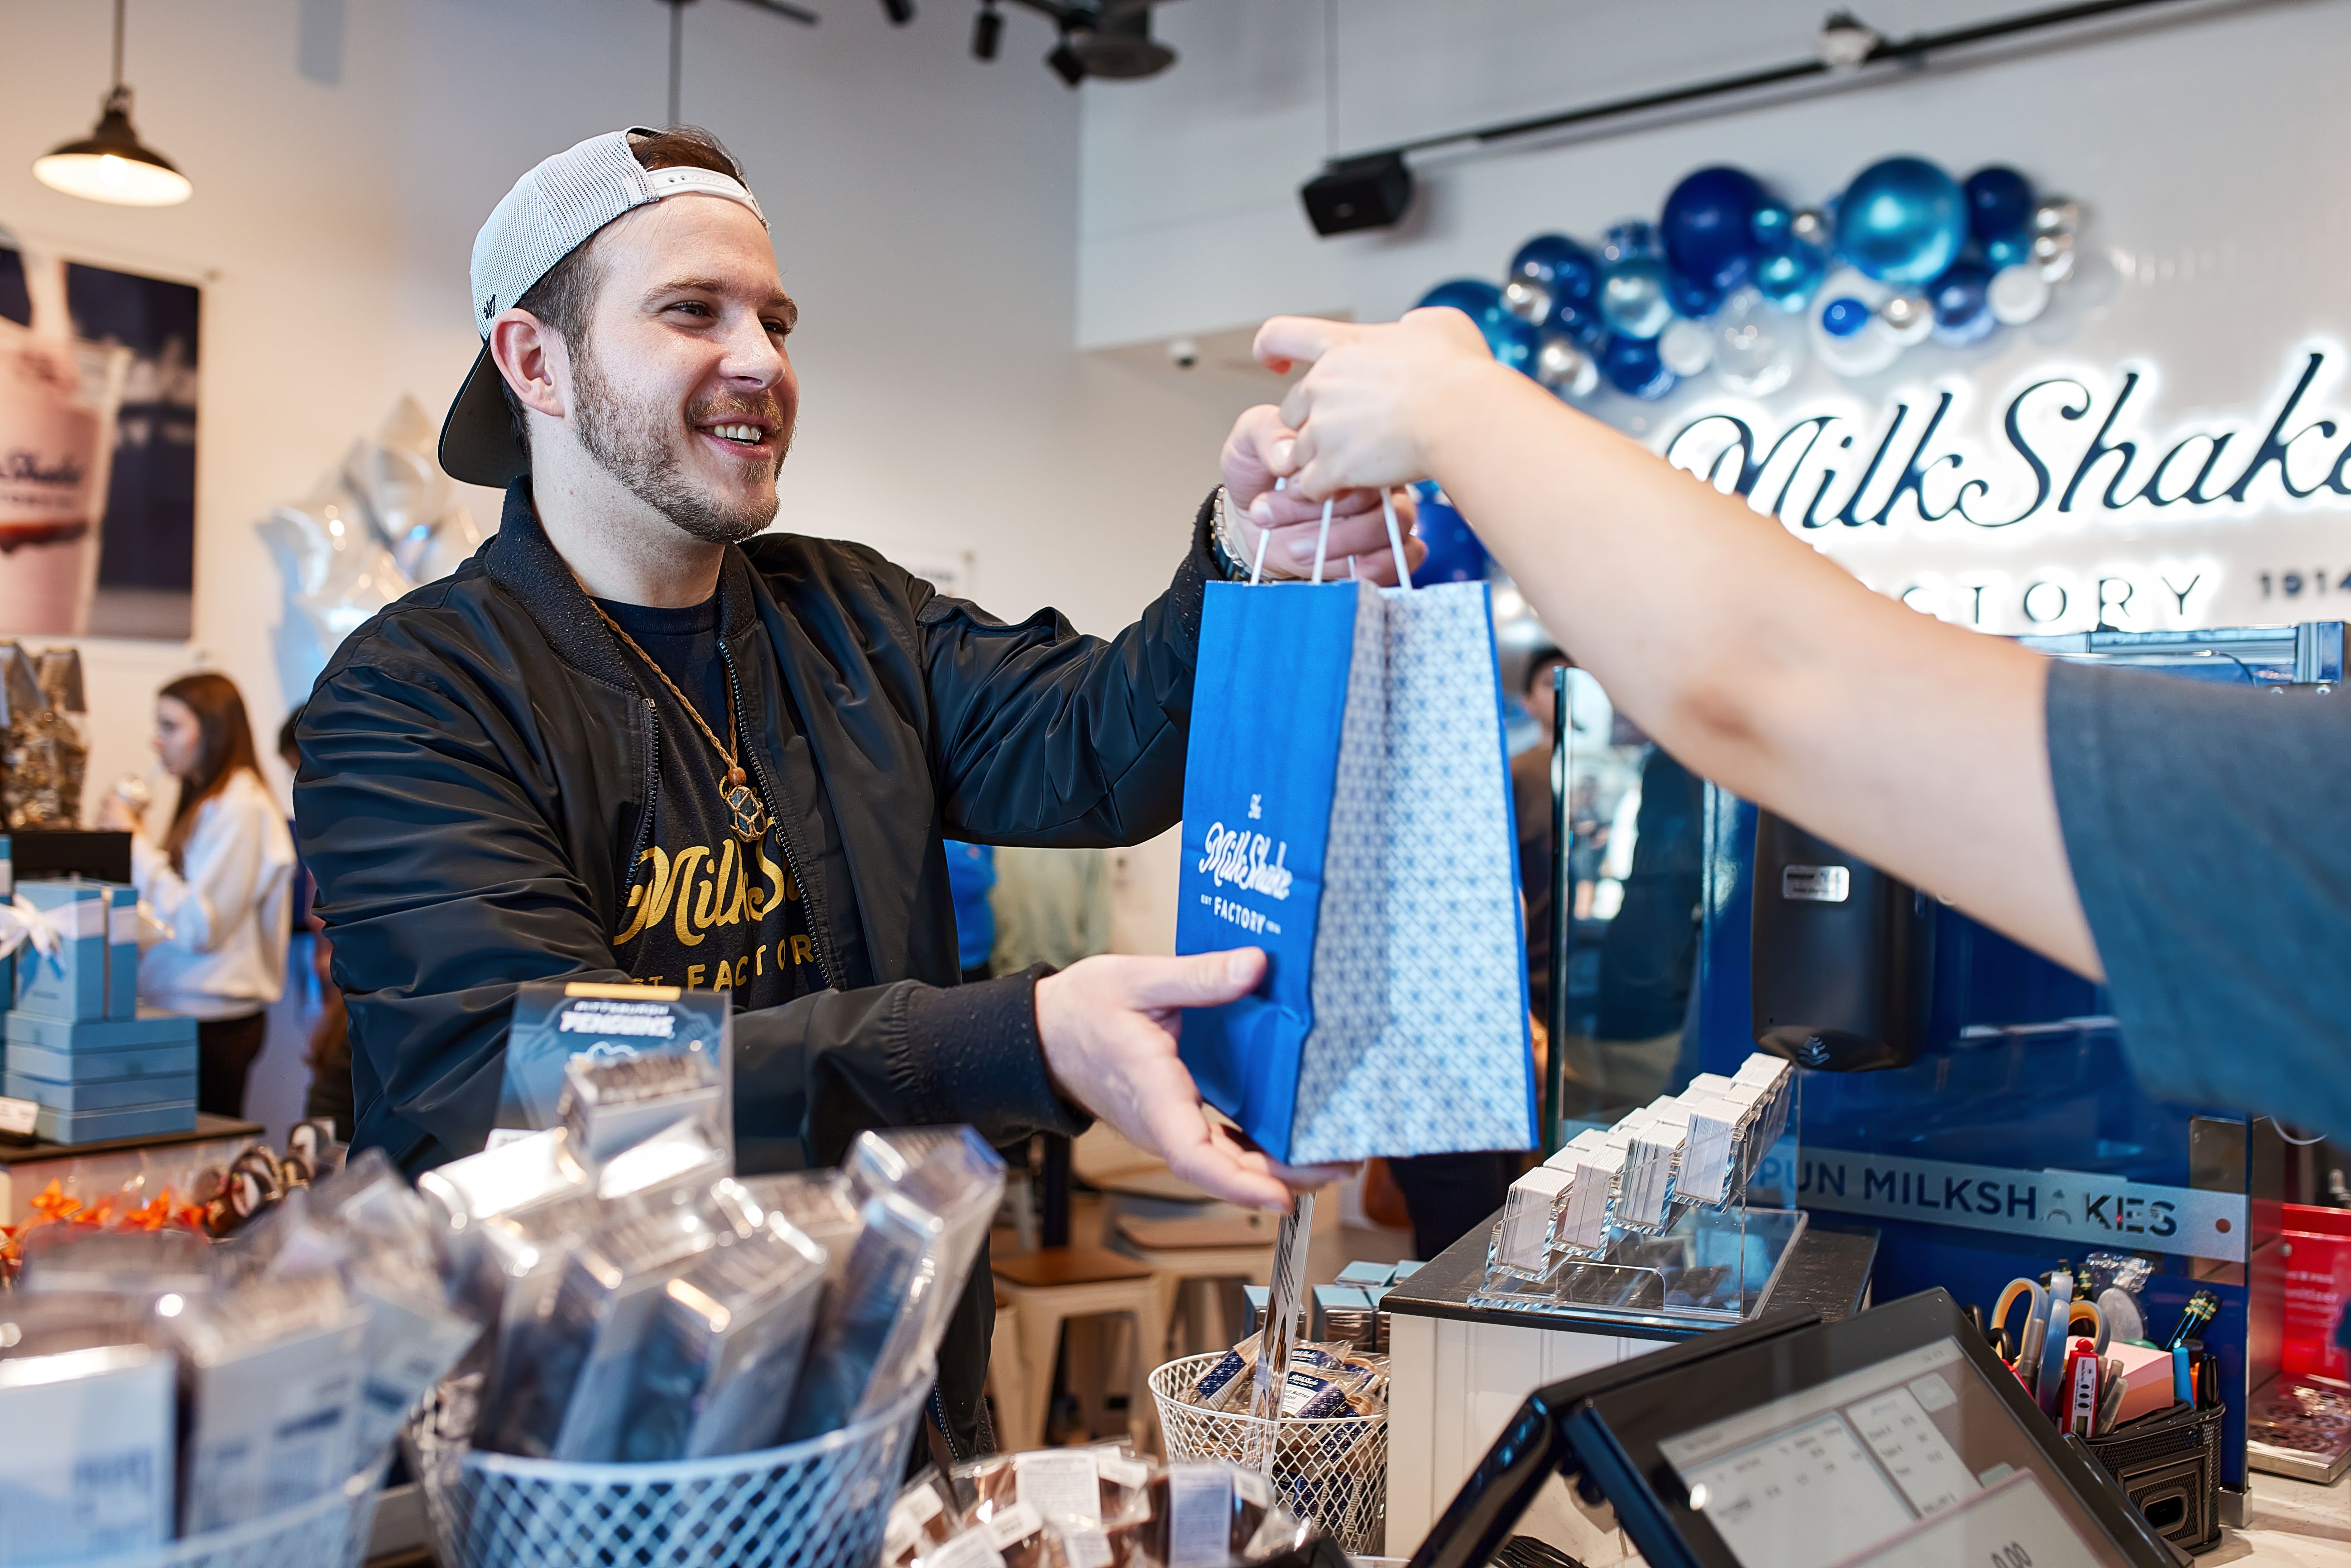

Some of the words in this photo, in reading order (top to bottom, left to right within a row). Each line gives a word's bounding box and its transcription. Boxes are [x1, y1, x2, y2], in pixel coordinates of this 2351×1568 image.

[1214, 896, 1267, 935] FACTORY
[687, 934, 814, 993] FACTOR
[1759, 1156, 1845, 1197] PUN
